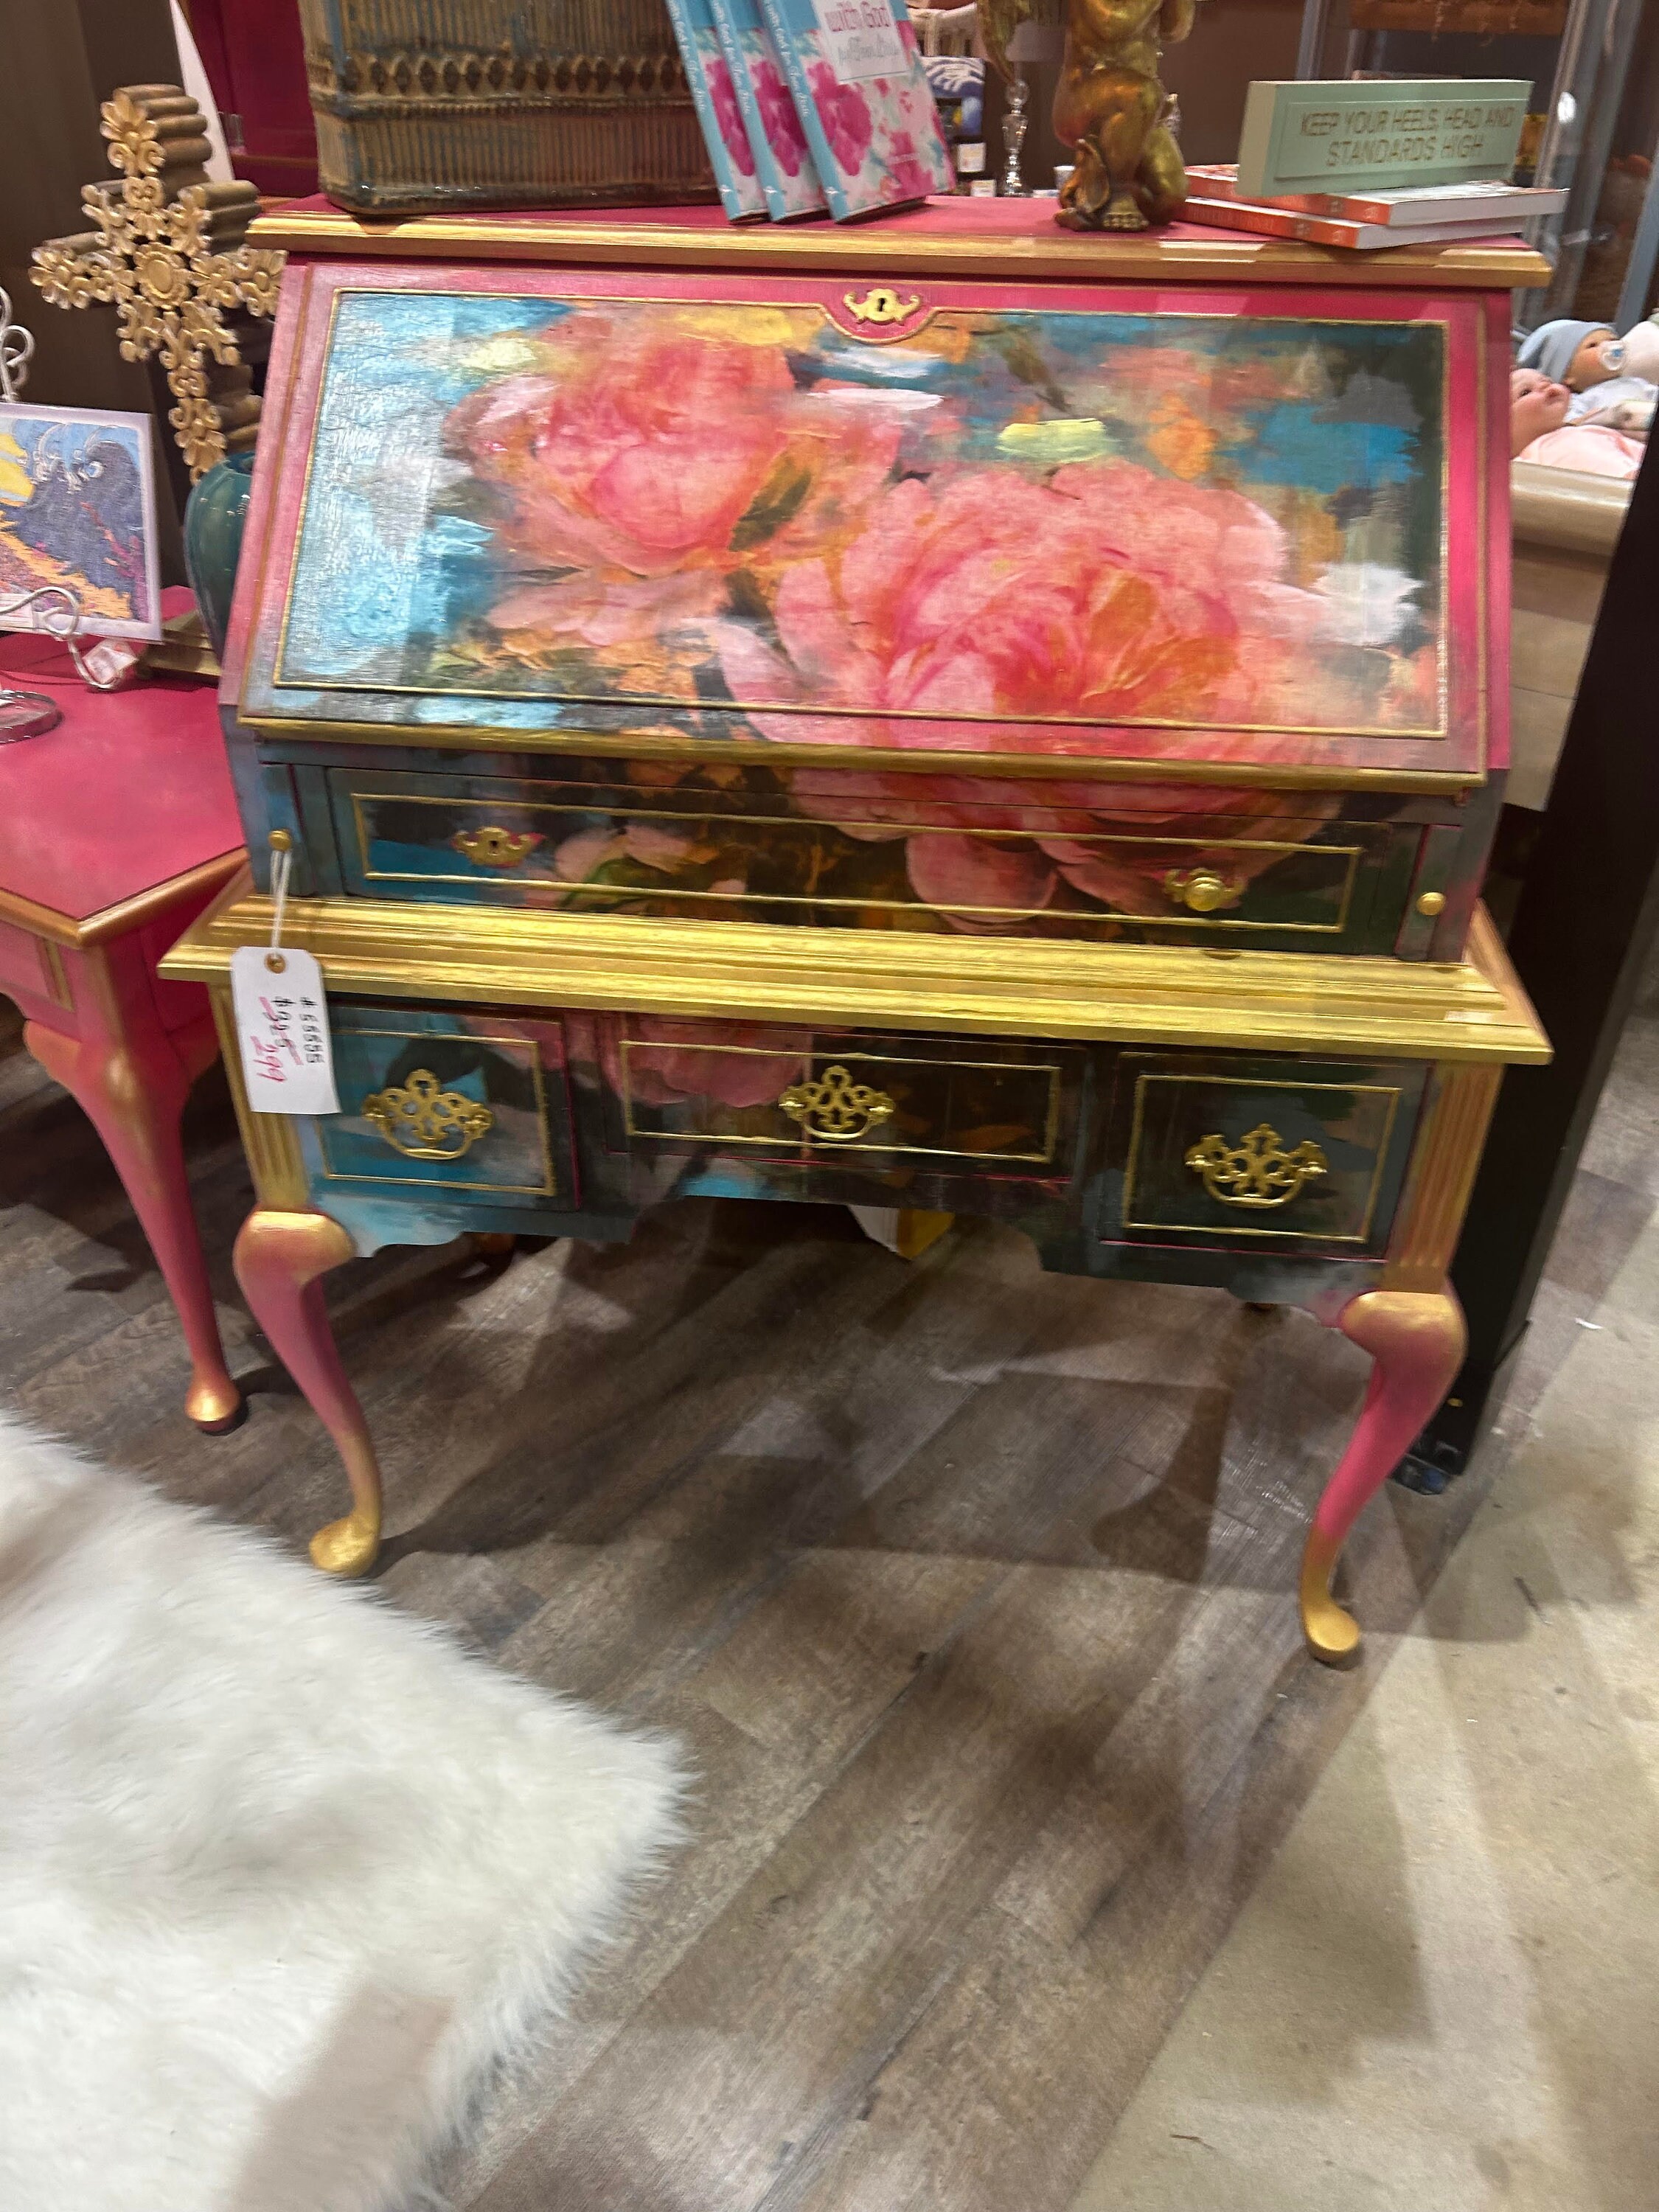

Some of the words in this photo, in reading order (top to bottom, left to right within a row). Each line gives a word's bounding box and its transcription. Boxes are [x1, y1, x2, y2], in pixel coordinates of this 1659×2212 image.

[824, 1, 862, 32] with
[1300, 111, 1340, 136] KEEP
[1344, 110, 1389, 134] YOUR
[1443, 107, 1483, 131] HEAD
[1484, 106, 1515, 128] AND
[1326, 135, 1437, 167] STANDARDS
[1440, 133, 1484, 159] HIGH
